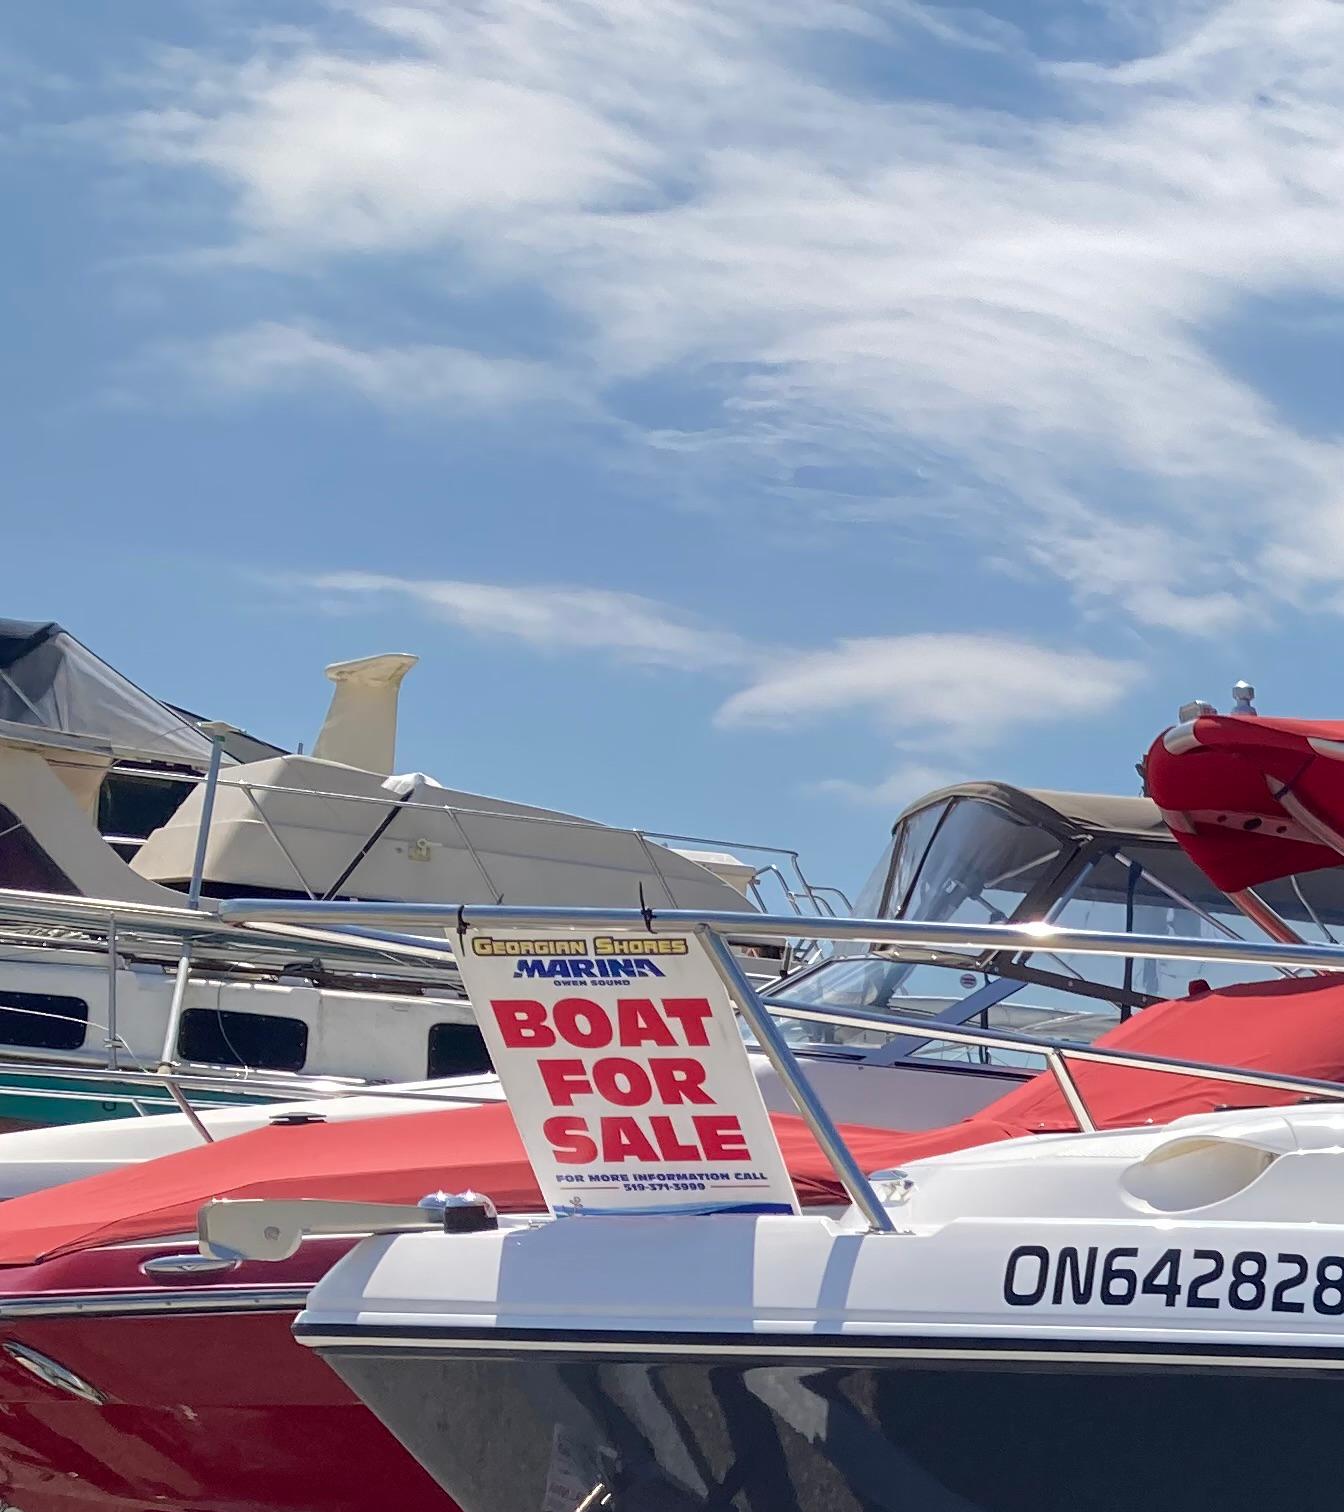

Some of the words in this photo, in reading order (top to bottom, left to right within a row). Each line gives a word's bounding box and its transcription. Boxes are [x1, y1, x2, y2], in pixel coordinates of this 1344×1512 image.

[472, 936, 589, 957] GEORGIAN
[594, 936, 689, 955] SHORES
[513, 958, 667, 979] MARINA
[553, 979, 587, 987] OWEN
[591, 979, 631, 987] SOUND
[490, 998, 713, 1049] BOAT
[536, 1057, 718, 1107] FOR
[543, 1116, 752, 1165] SALE
[556, 1174, 585, 1183] FOR
[588, 1174, 629, 1182] MORE
[633, 1173, 730, 1182] INFORMATION
[734, 1172, 768, 1181] CALL
